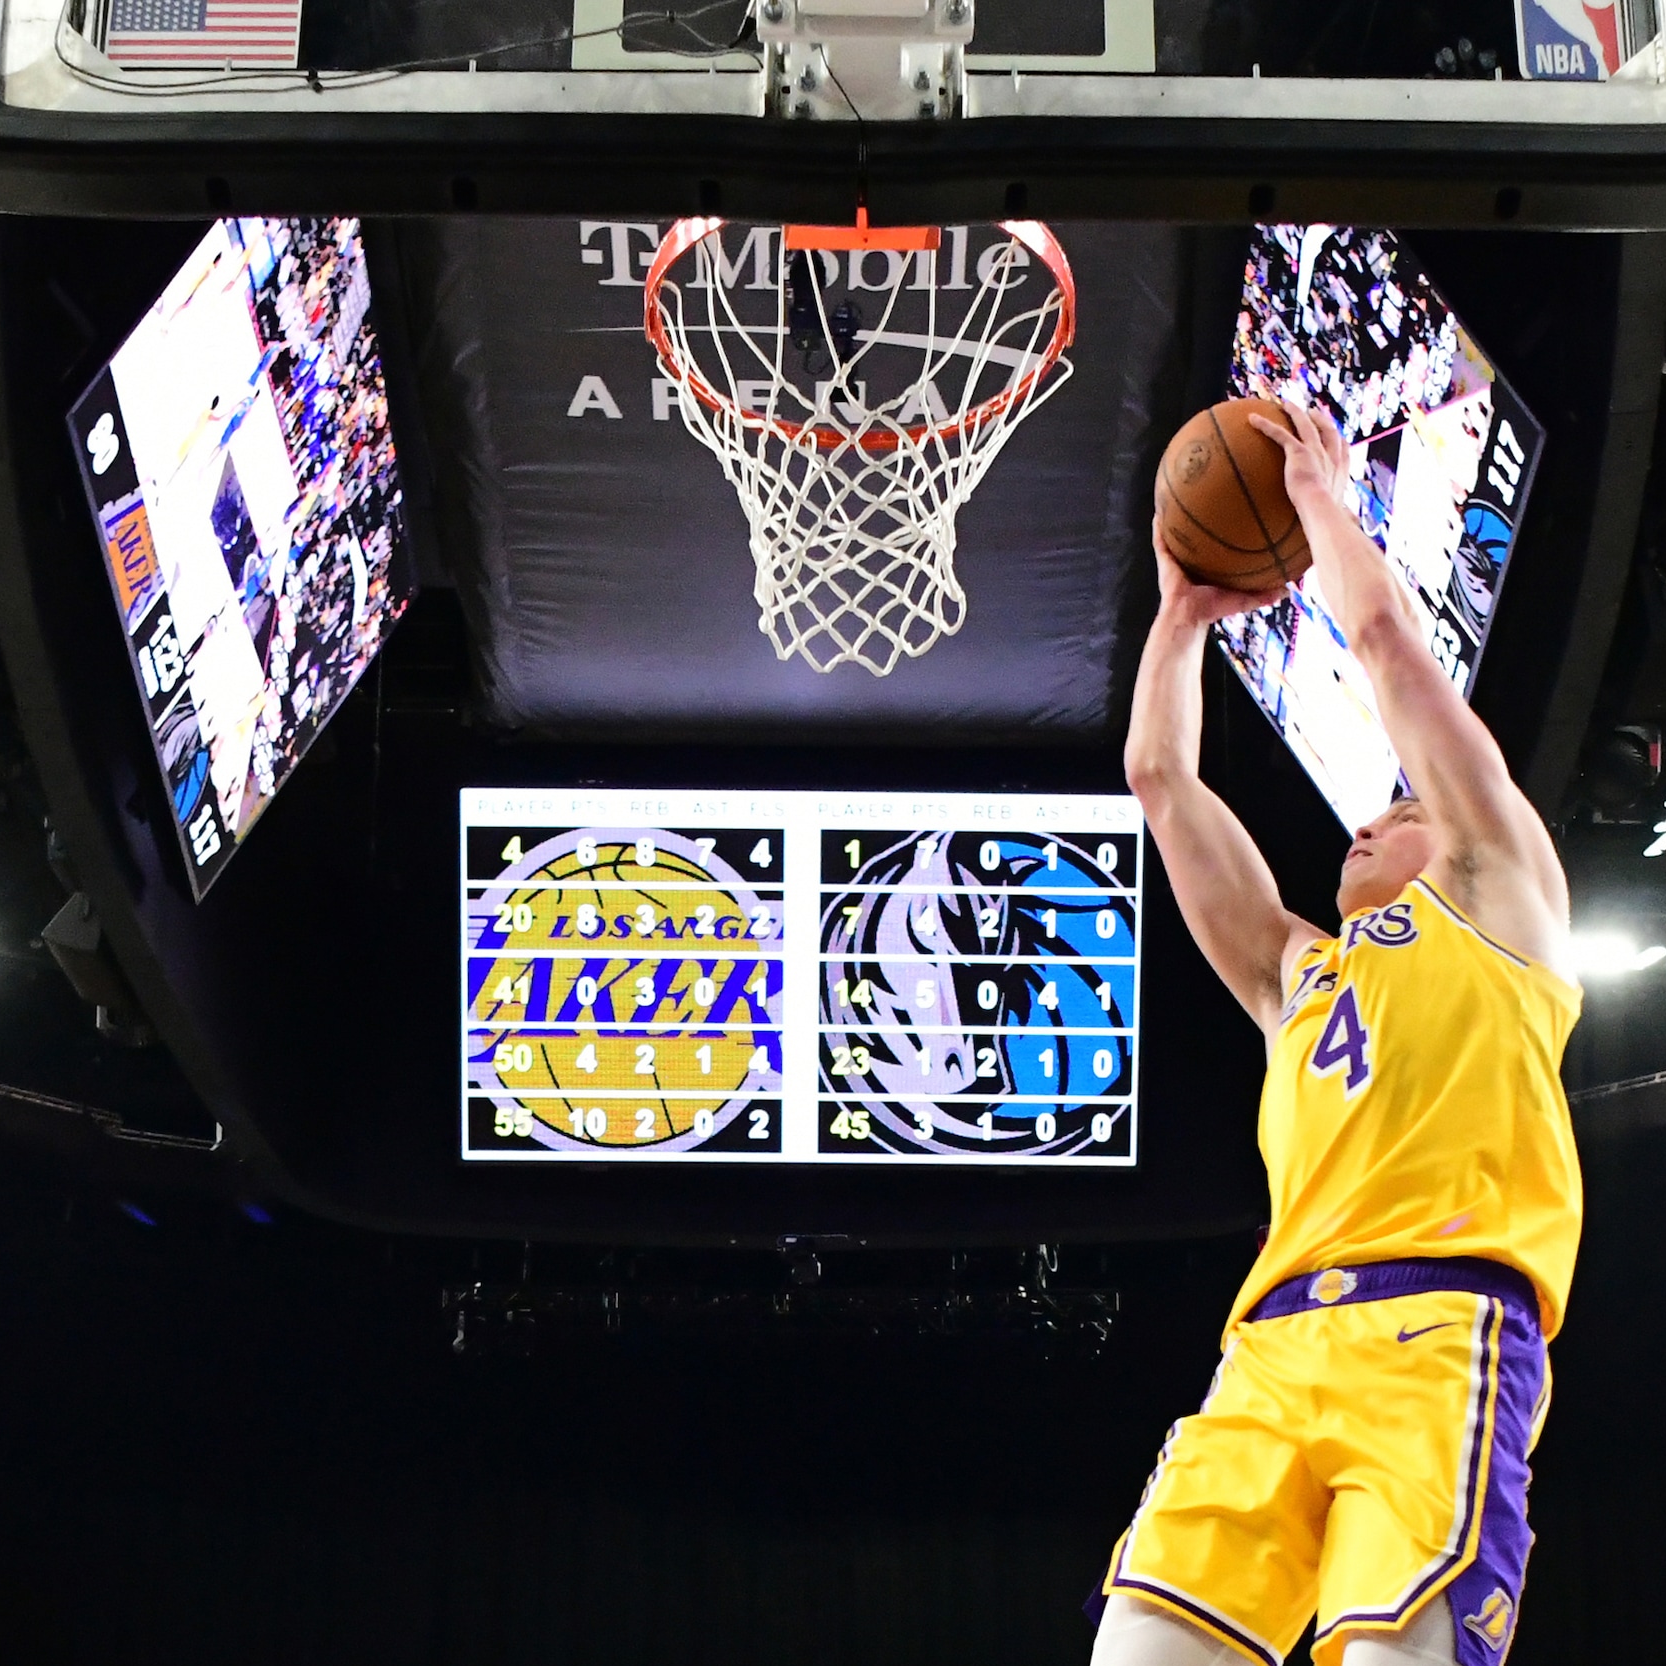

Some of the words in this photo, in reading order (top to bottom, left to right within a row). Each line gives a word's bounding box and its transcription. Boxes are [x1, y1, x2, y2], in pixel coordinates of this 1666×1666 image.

[1536, 44, 1585, 74] NBA
[567, 376, 953, 423] ARENA
[1487, 418, 1526, 505] 117
[478, 800, 553, 815] PLAYER
[572, 801, 607, 815] PTS
[631, 802, 669, 816] REB
[694, 802, 729, 816] AST
[818, 803, 893, 817] PLAYER
[912, 804, 949, 818] PTS
[973, 805, 1012, 819] REB
[502, 836, 523, 865] 4
[577, 837, 597, 866] 6
[636, 837, 656, 866] 8
[696, 838, 716, 867] 7
[750, 838, 772, 867] 4
[844, 839, 860, 868] 1
[917, 840, 938, 869] 7
[980, 841, 1000, 870] 0
[1042, 842, 1057, 871] 1
[1098, 843, 1118, 872] 0
[493, 904, 533, 932] 20
[577, 905, 597, 934] 8
[636, 905, 655, 934] 3
[696, 905, 715, 935] 2
[750, 906, 770, 935] 2
[843, 907, 862, 935] 7
[915, 908, 936, 936] 4
[979, 908, 999, 937] 2
[1041, 909, 1056, 938] 1
[1096, 909, 1116, 939] 0
[493, 976, 530, 1004] 41
[576, 976, 597, 1005] 0
[636, 977, 655, 1006] 3
[694, 977, 715, 1007] 0
[751, 978, 767, 1007] 1
[834, 979, 871, 1007] 14
[915, 980, 935, 1009] 5
[977, 980, 998, 1010] 0
[1037, 981, 1058, 1010] 4
[1095, 982, 1111, 1011] 1
[1308, 980, 1374, 1102] 4
[494, 1044, 532, 1072] 50
[576, 1044, 597, 1073] 4
[635, 1045, 655, 1074] 2
[696, 1045, 711, 1074] 1
[748, 1046, 770, 1074] 4
[832, 1047, 870, 1075] 23
[916, 1048, 931, 1076] 1
[976, 1048, 997, 1077] 2
[1038, 1049, 1054, 1078] 1
[1093, 1049, 1113, 1079] 0
[494, 1108, 533, 1137] 55
[568, 1108, 607, 1138] 10
[635, 1109, 655, 1138] 2
[694, 1109, 714, 1138] 0
[748, 1110, 770, 1139] 2
[830, 1111, 870, 1139] 45
[913, 1111, 933, 1140] 3
[977, 1112, 993, 1141] 1
[1035, 1113, 1056, 1142] 0
[1091, 1113, 1112, 1142] 0
